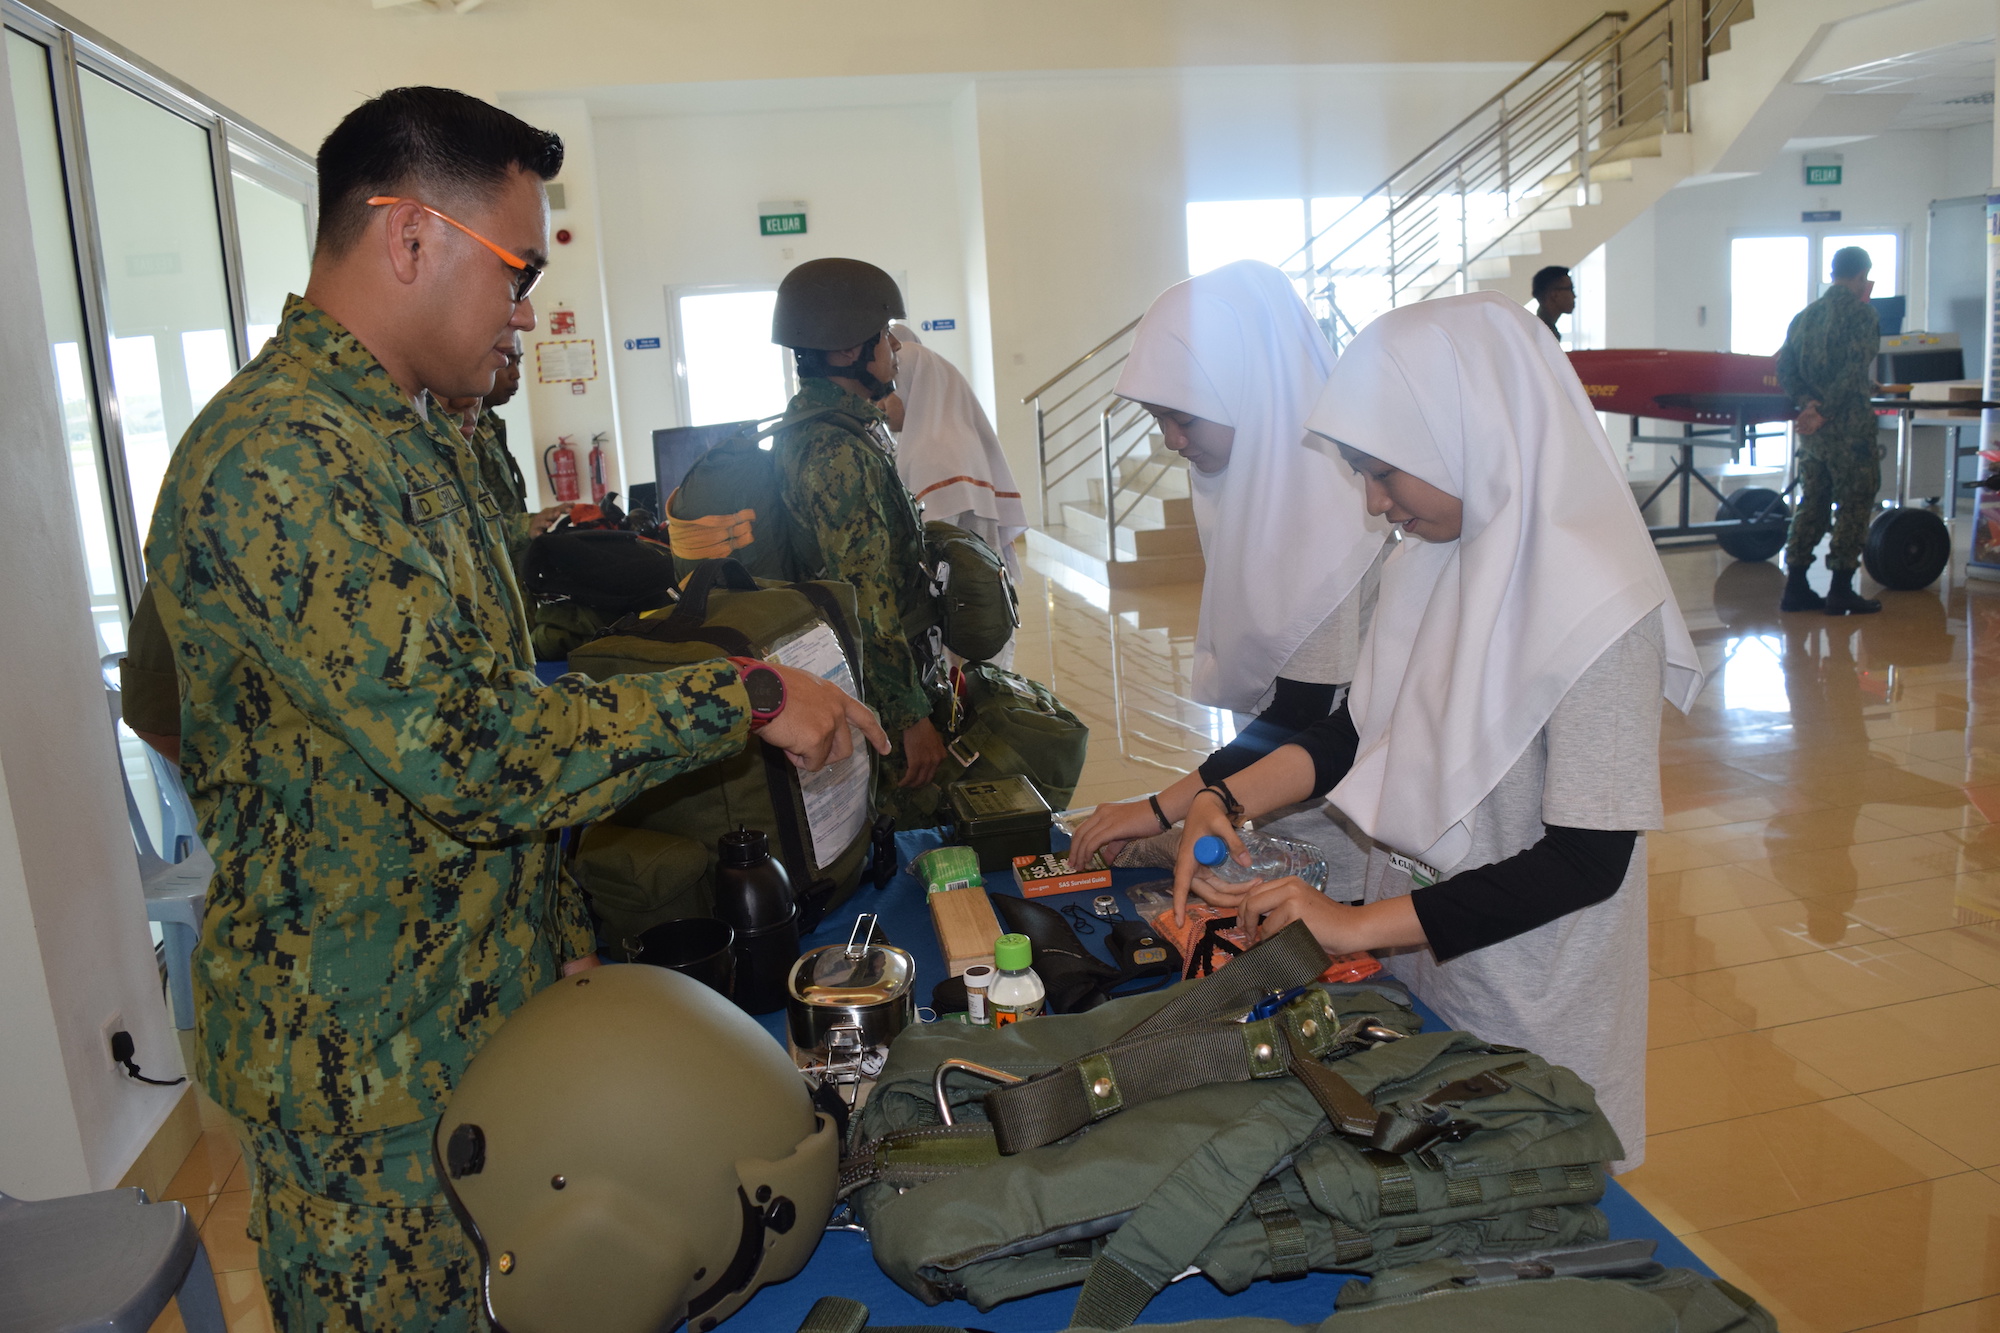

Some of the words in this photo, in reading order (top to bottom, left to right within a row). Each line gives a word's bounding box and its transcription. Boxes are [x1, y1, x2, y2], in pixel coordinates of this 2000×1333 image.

[766, 217, 801, 232] KELUAR
[1030, 865, 1049, 879] SAS
[1070, 879, 1091, 887] Survival
[1091, 876, 1107, 884] Guide
